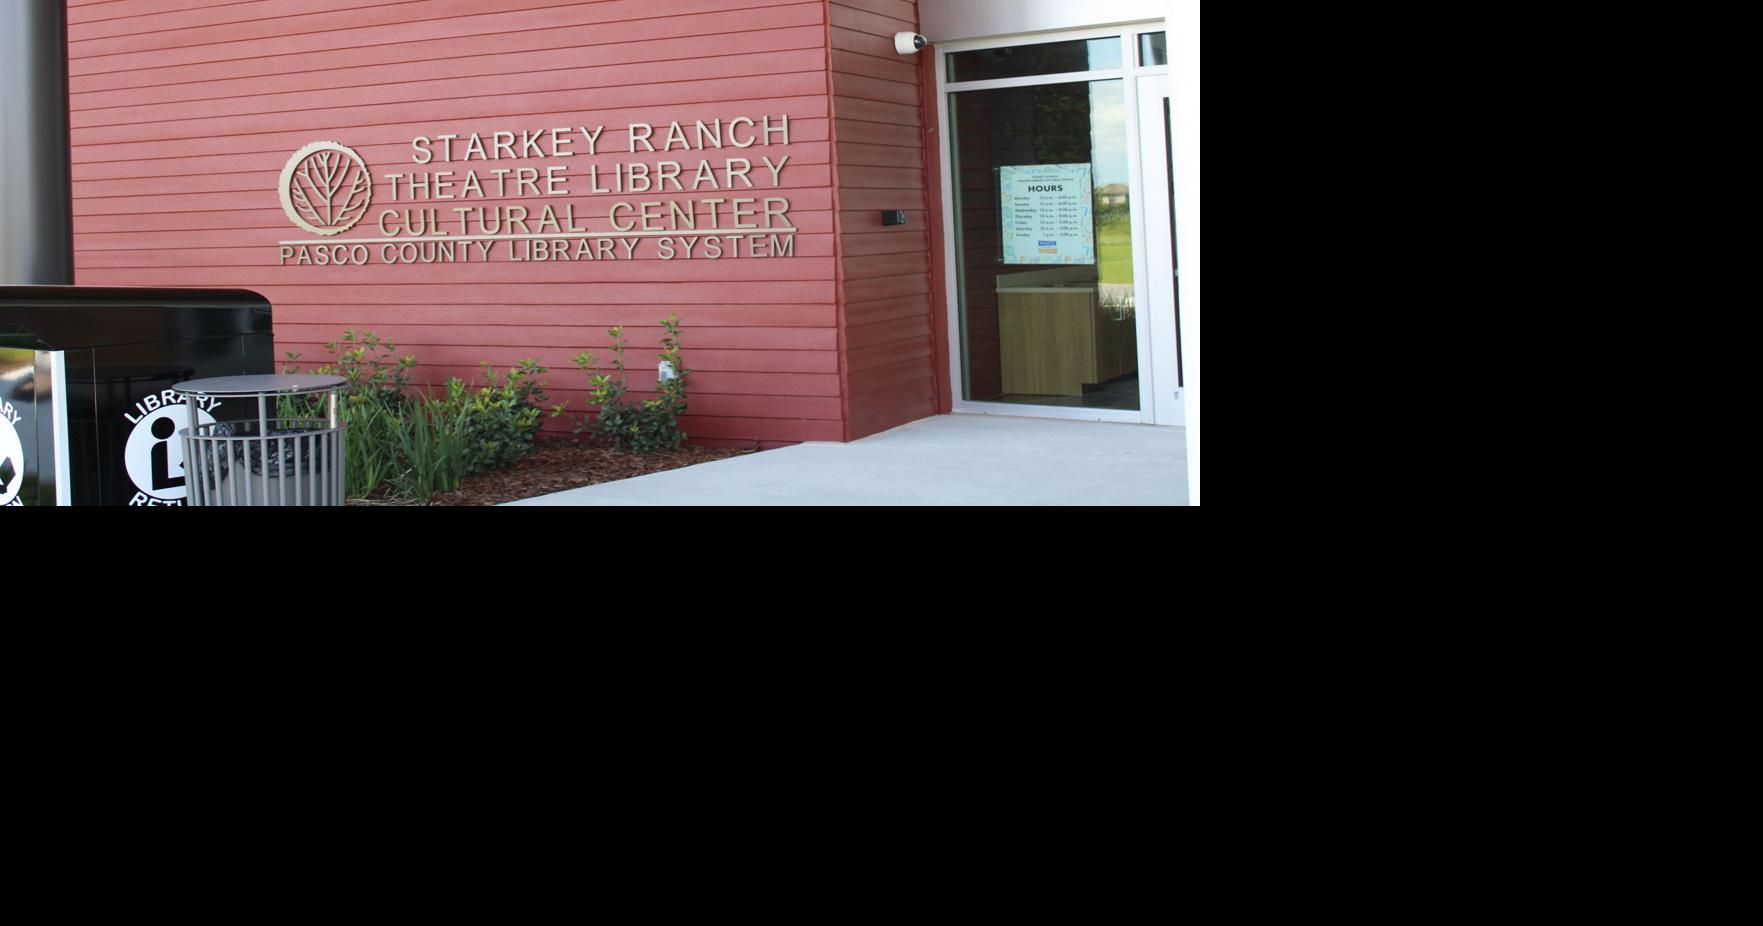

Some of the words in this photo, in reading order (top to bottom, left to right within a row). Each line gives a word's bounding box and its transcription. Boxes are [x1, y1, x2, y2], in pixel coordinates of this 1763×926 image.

[412, 125, 604, 165] STARKEY
[629, 114, 790, 154] RANCH
[385, 165, 569, 201] THEATRE
[591, 155, 790, 194] LIBRARY
[1028, 184, 1063, 192] HOURS
[379, 204, 587, 237] CULTURAL
[609, 197, 792, 233] CENTER
[280, 244, 369, 266] PASCO
[381, 240, 497, 264] COUNTY
[509, 237, 640, 262] LIBRARY
[658, 234, 796, 259] SYSTEM
